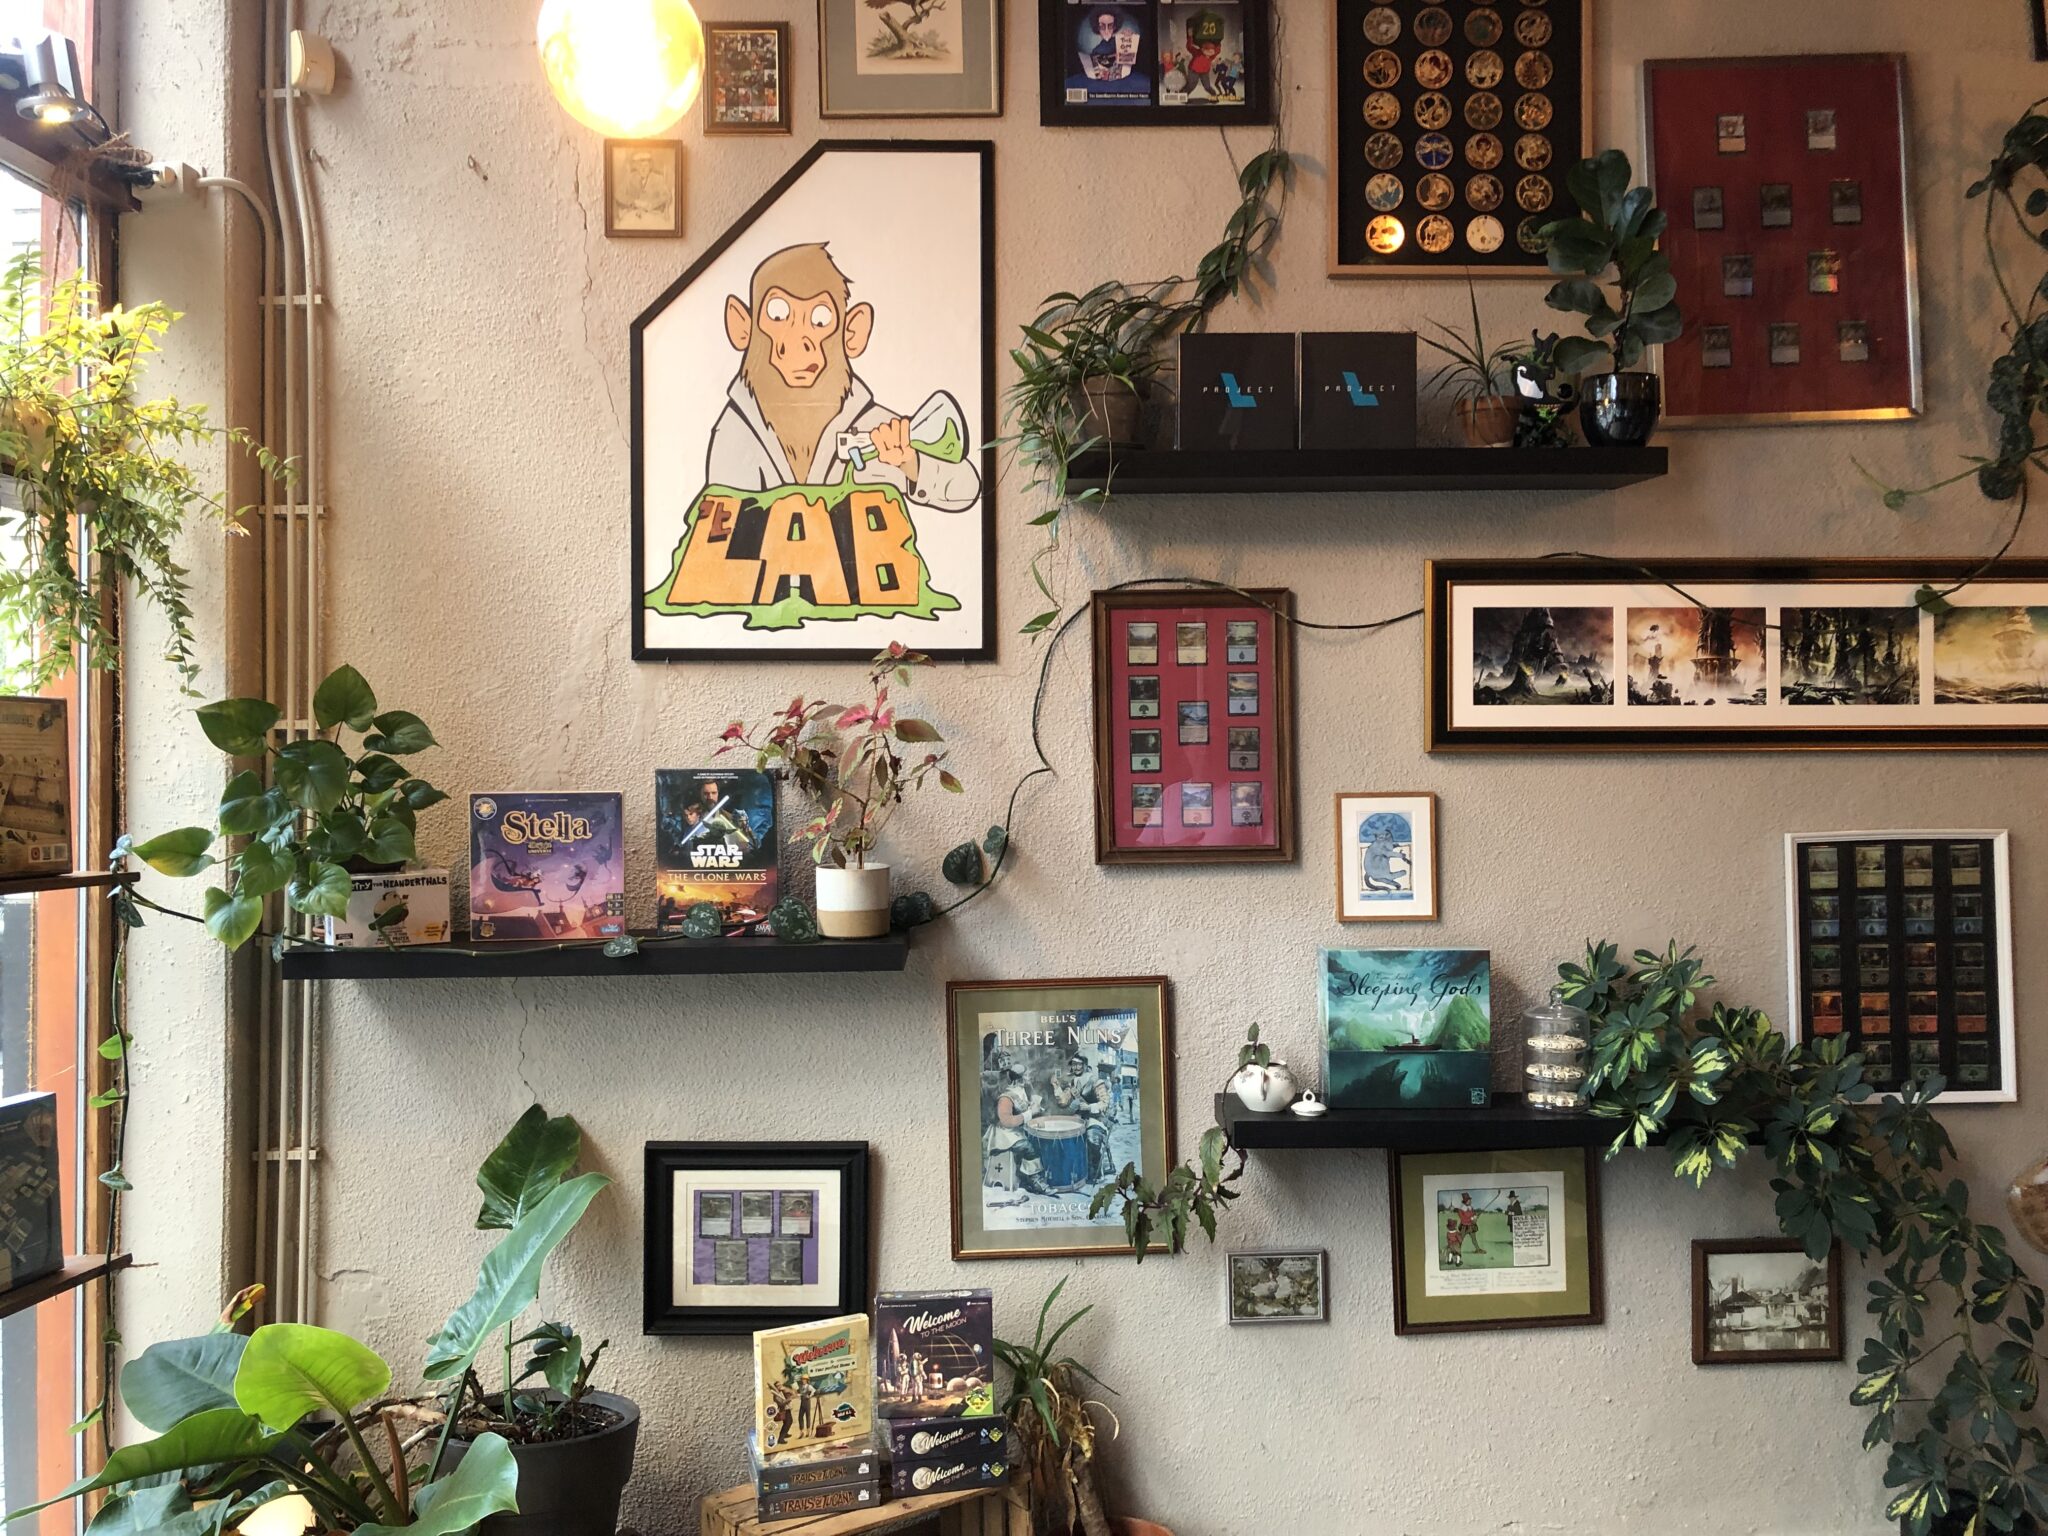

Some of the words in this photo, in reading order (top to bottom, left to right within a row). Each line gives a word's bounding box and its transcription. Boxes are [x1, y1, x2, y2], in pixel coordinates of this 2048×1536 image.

[501, 811, 592, 844] Stella
[690, 844, 743, 856] STAR
[690, 855, 743, 868] WARS
[383, 876, 448, 888] NEANDERTHALS
[668, 873, 689, 881] THE
[694, 873, 730, 881] CLONE
[735, 873, 767, 881] WARS
[1336, 972, 1422, 1010] Sleeping
[1427, 973, 1482, 1011] Gods
[1040, 1014, 1077, 1023] BELL'S
[995, 1028, 1056, 1047] THREE
[1067, 1026, 1122, 1045] NUNS
[903, 1308, 961, 1334] Welcome
[920, 1331, 930, 1339] TO
[931, 1325, 945, 1335] THE
[945, 1316, 967, 1329] MOON
[793, 1337, 846, 1366] Welcome
[922, 1428, 964, 1450] Welcome
[949, 1439, 960, 1447] THE
[960, 1431, 977, 1441] MOON
[923, 1463, 965, 1485] Welcome
[951, 1474, 961, 1482] THE
[961, 1466, 978, 1476] MOON
[822, 1490, 855, 1509] TUCANA
